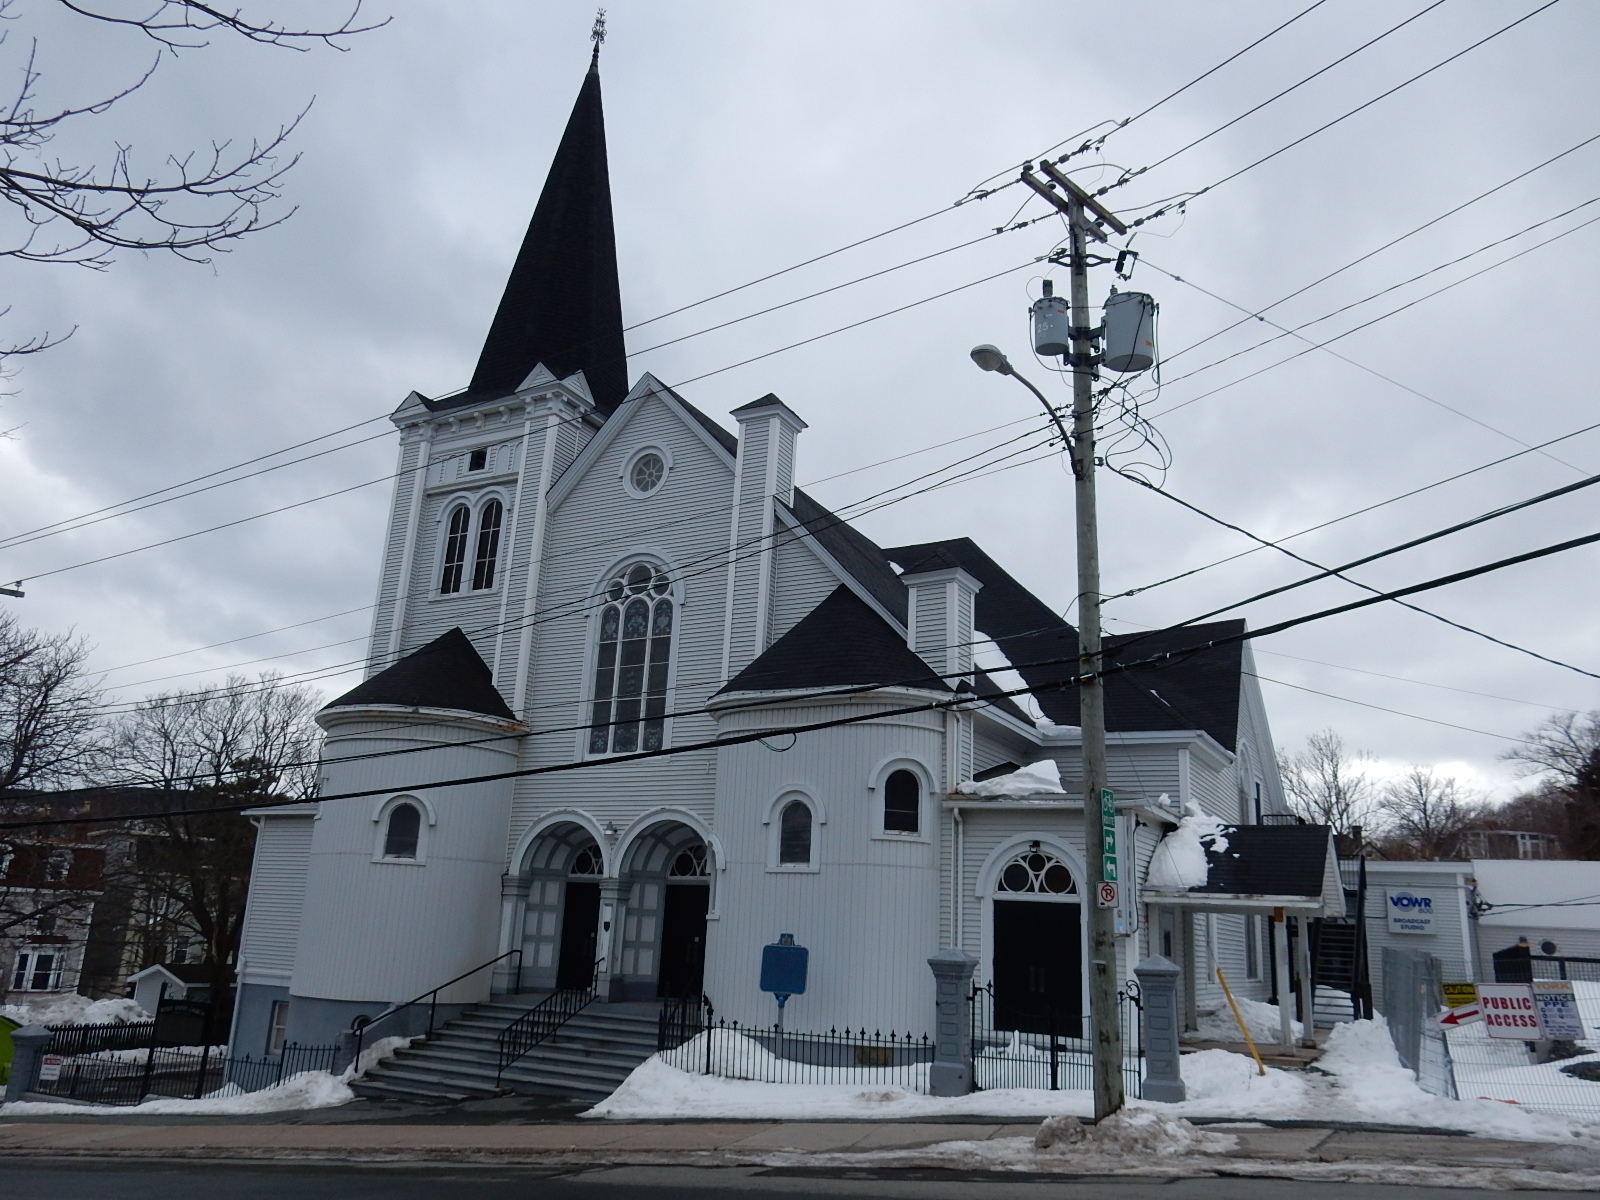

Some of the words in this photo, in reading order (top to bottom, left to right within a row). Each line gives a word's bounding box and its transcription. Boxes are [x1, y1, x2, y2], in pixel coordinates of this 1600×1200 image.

[1389, 896, 1432, 907] VOWR
[1482, 997, 1532, 1010] PUBLIC
[1486, 1014, 1538, 1027] ACCESS
